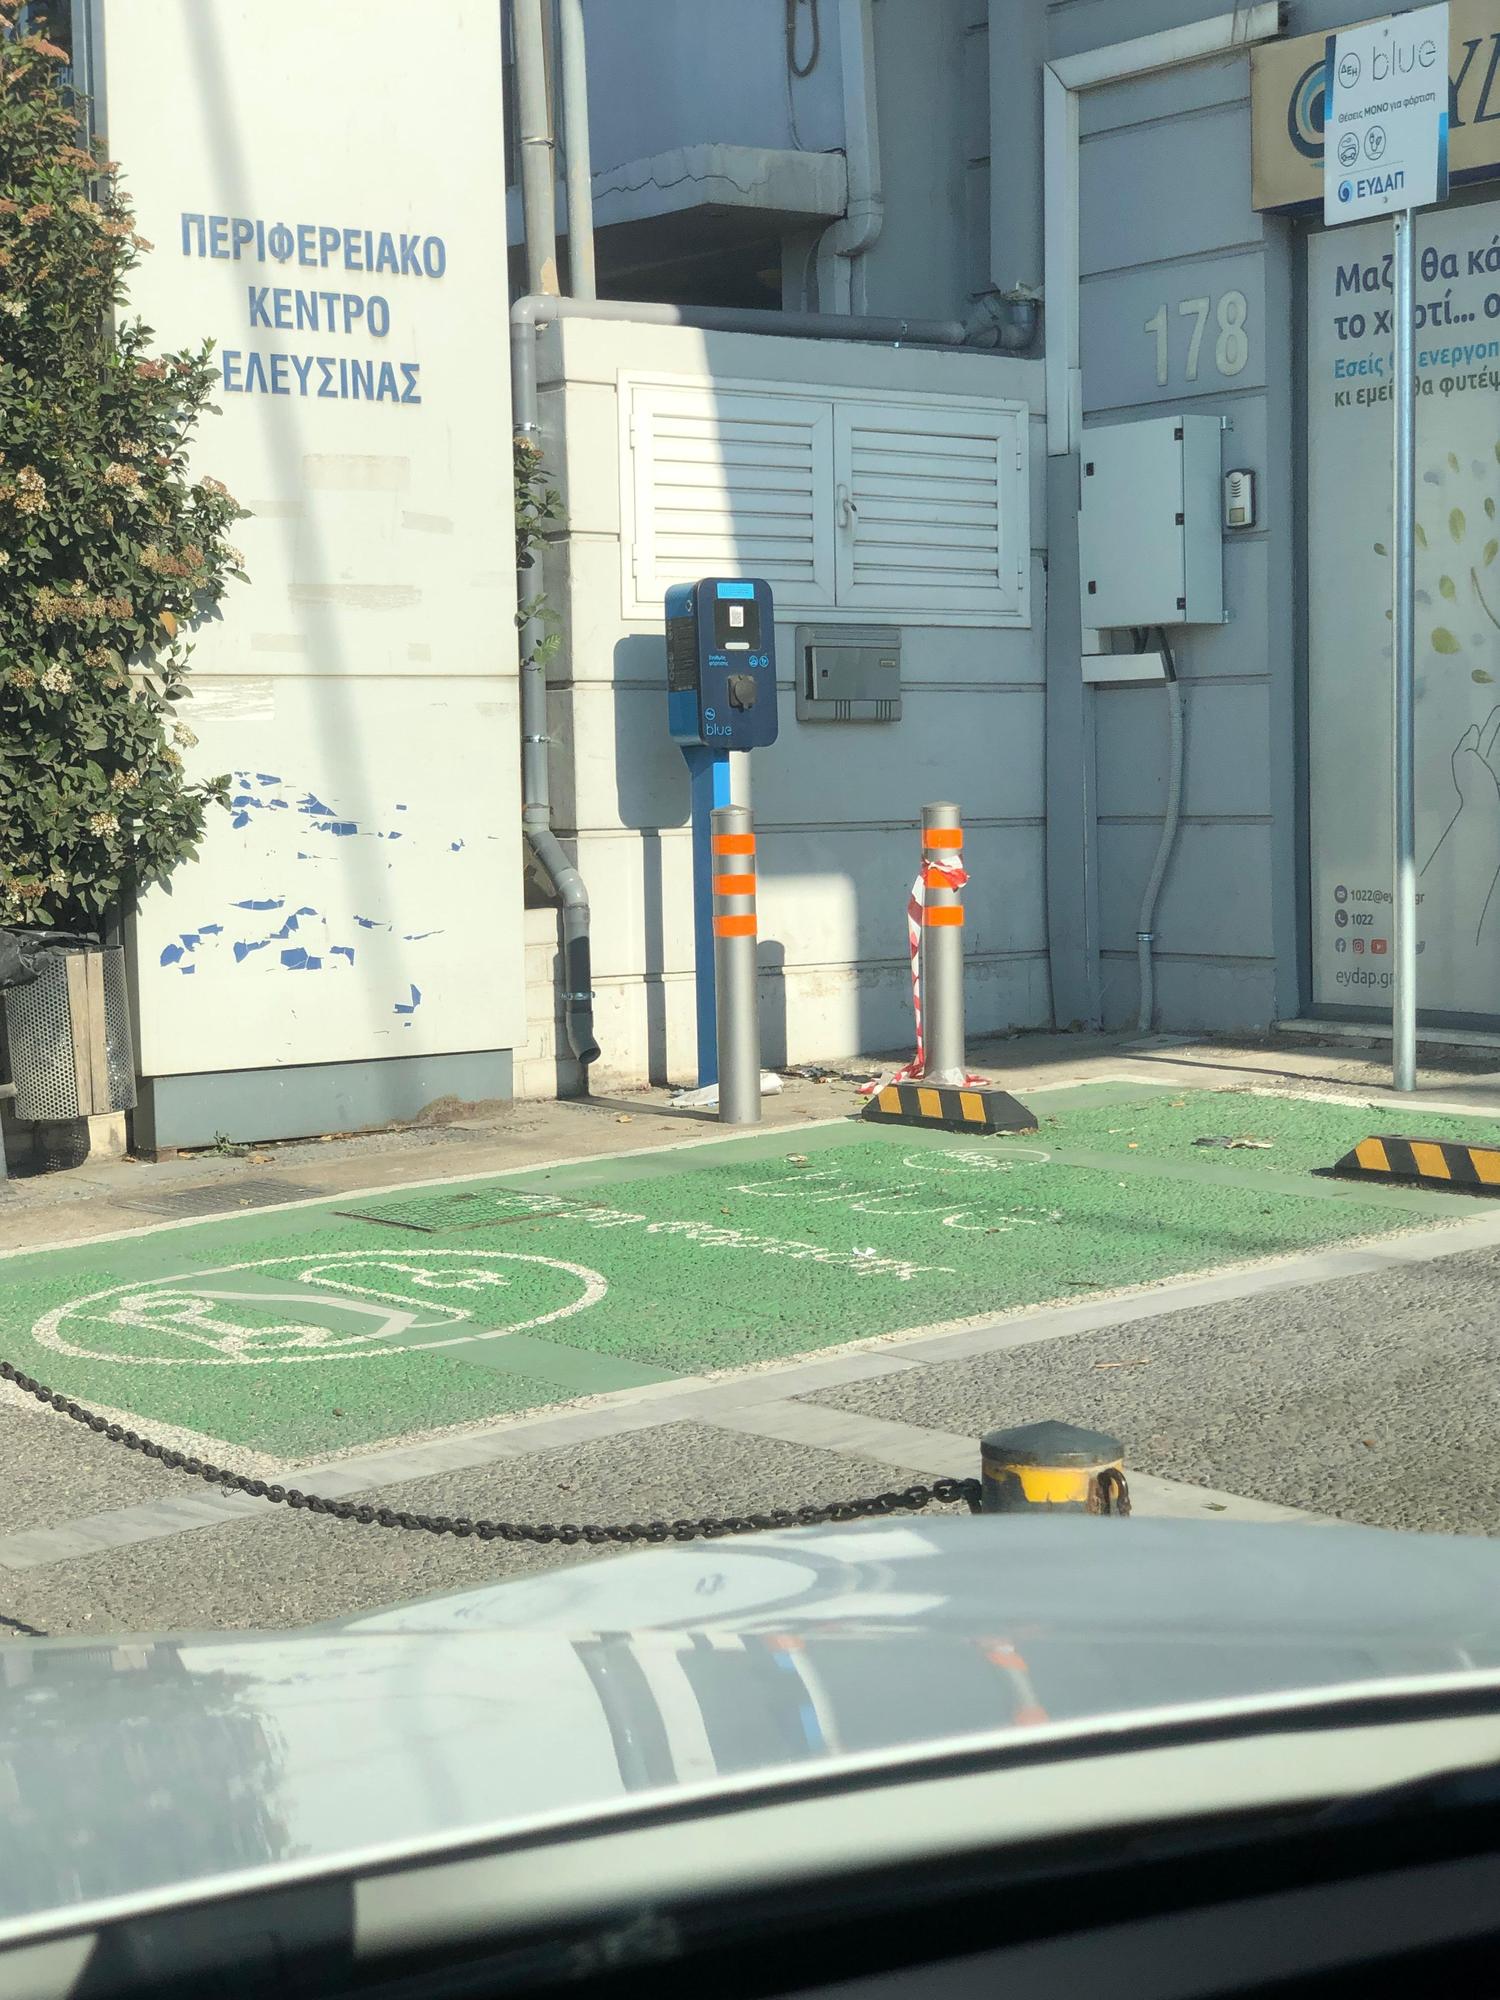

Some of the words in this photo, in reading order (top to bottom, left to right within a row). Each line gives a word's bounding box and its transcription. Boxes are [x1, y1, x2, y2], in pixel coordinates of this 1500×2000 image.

[1341, 65, 1358, 77] ΔΕΗ
[1372, 40, 1436, 81] blue
[1338, 112, 1363, 124] Θέσεις
[1364, 102, 1389, 117] ΜΟΝΟ
[1390, 100, 1402, 111] για
[1403, 91, 1436, 109] φόρτιση
[1357, 171, 1404, 198] ΕΥΔΑΠ
[181, 213, 446, 279] ΠΕΡΙΦΕΡΕΙΑΚΟ
[1335, 254, 1394, 297] Μαζ
[1421, 246, 1459, 283] θα
[248, 285, 390, 338] ΚΕΝΤΡΟ
[1334, 313, 1366, 341] το
[1373, 288, 1475, 336] χρτί...
[1143, 289, 1248, 387] 178
[222, 350, 422, 404] ΕΛΕΥΣΙΝΑΣ
[1334, 351, 1384, 379] Εσείς
[1334, 390, 1351, 408] κι
[1356, 377, 1394, 408] εμεί
[706, 723, 732, 736] blue
[1351, 914, 1374, 926] 1022
